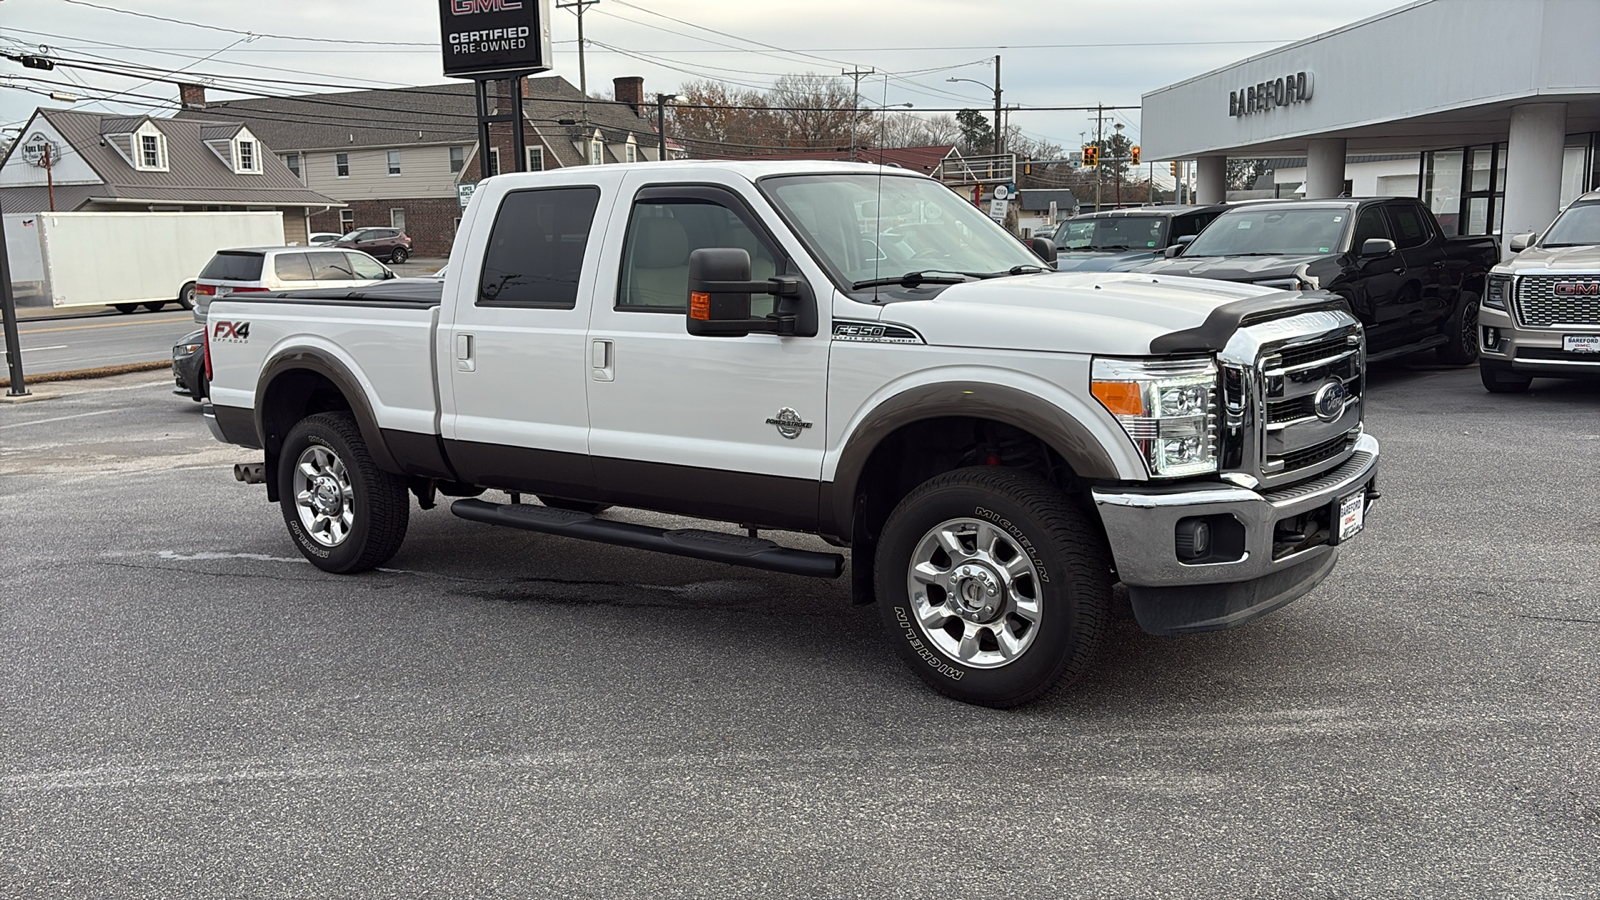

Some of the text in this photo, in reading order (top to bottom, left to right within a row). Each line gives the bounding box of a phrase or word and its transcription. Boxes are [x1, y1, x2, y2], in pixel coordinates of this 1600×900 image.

[451, 0, 523, 16] GMC
[449, 26, 529, 44] CERTIFIED
[453, 38, 526, 55] PRE-OWNED
[1229, 70, 1315, 117] BAREFORD
[1556, 283, 1600, 295] GM
[214, 320, 251, 339] FX4
[975, 506, 1050, 583] MICHELIN
[894, 606, 965, 681] MICHELIN
